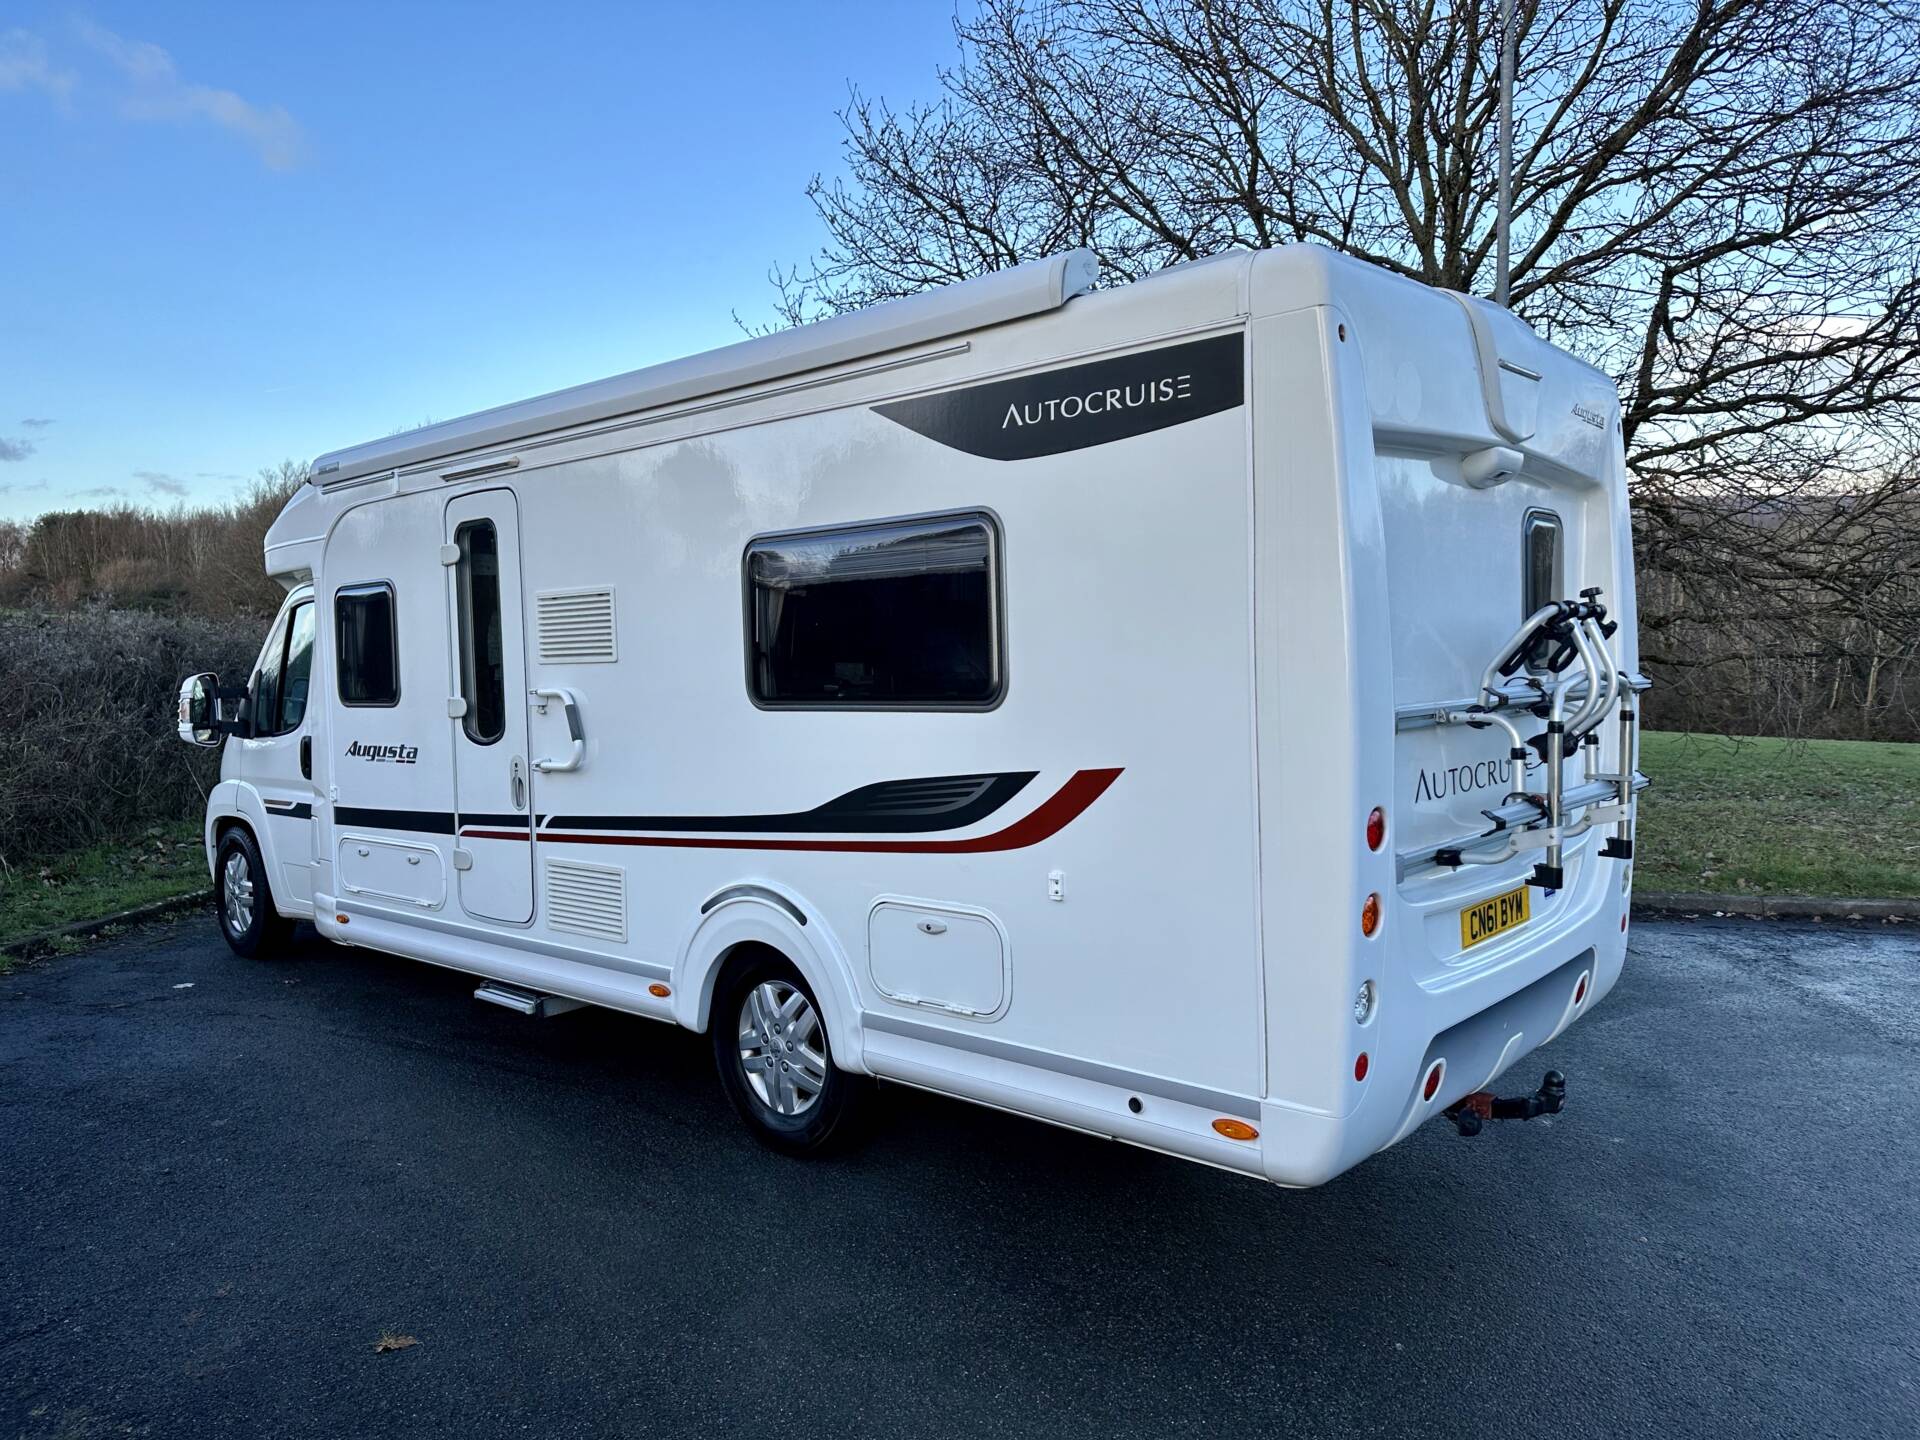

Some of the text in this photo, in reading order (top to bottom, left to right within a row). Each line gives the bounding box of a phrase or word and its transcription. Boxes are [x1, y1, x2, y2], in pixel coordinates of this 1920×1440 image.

[1002, 375, 1191, 428] AUTOCRUISE
[345, 740, 418, 762] Augusta
[1470, 891, 1523, 940] CN61 BYM
